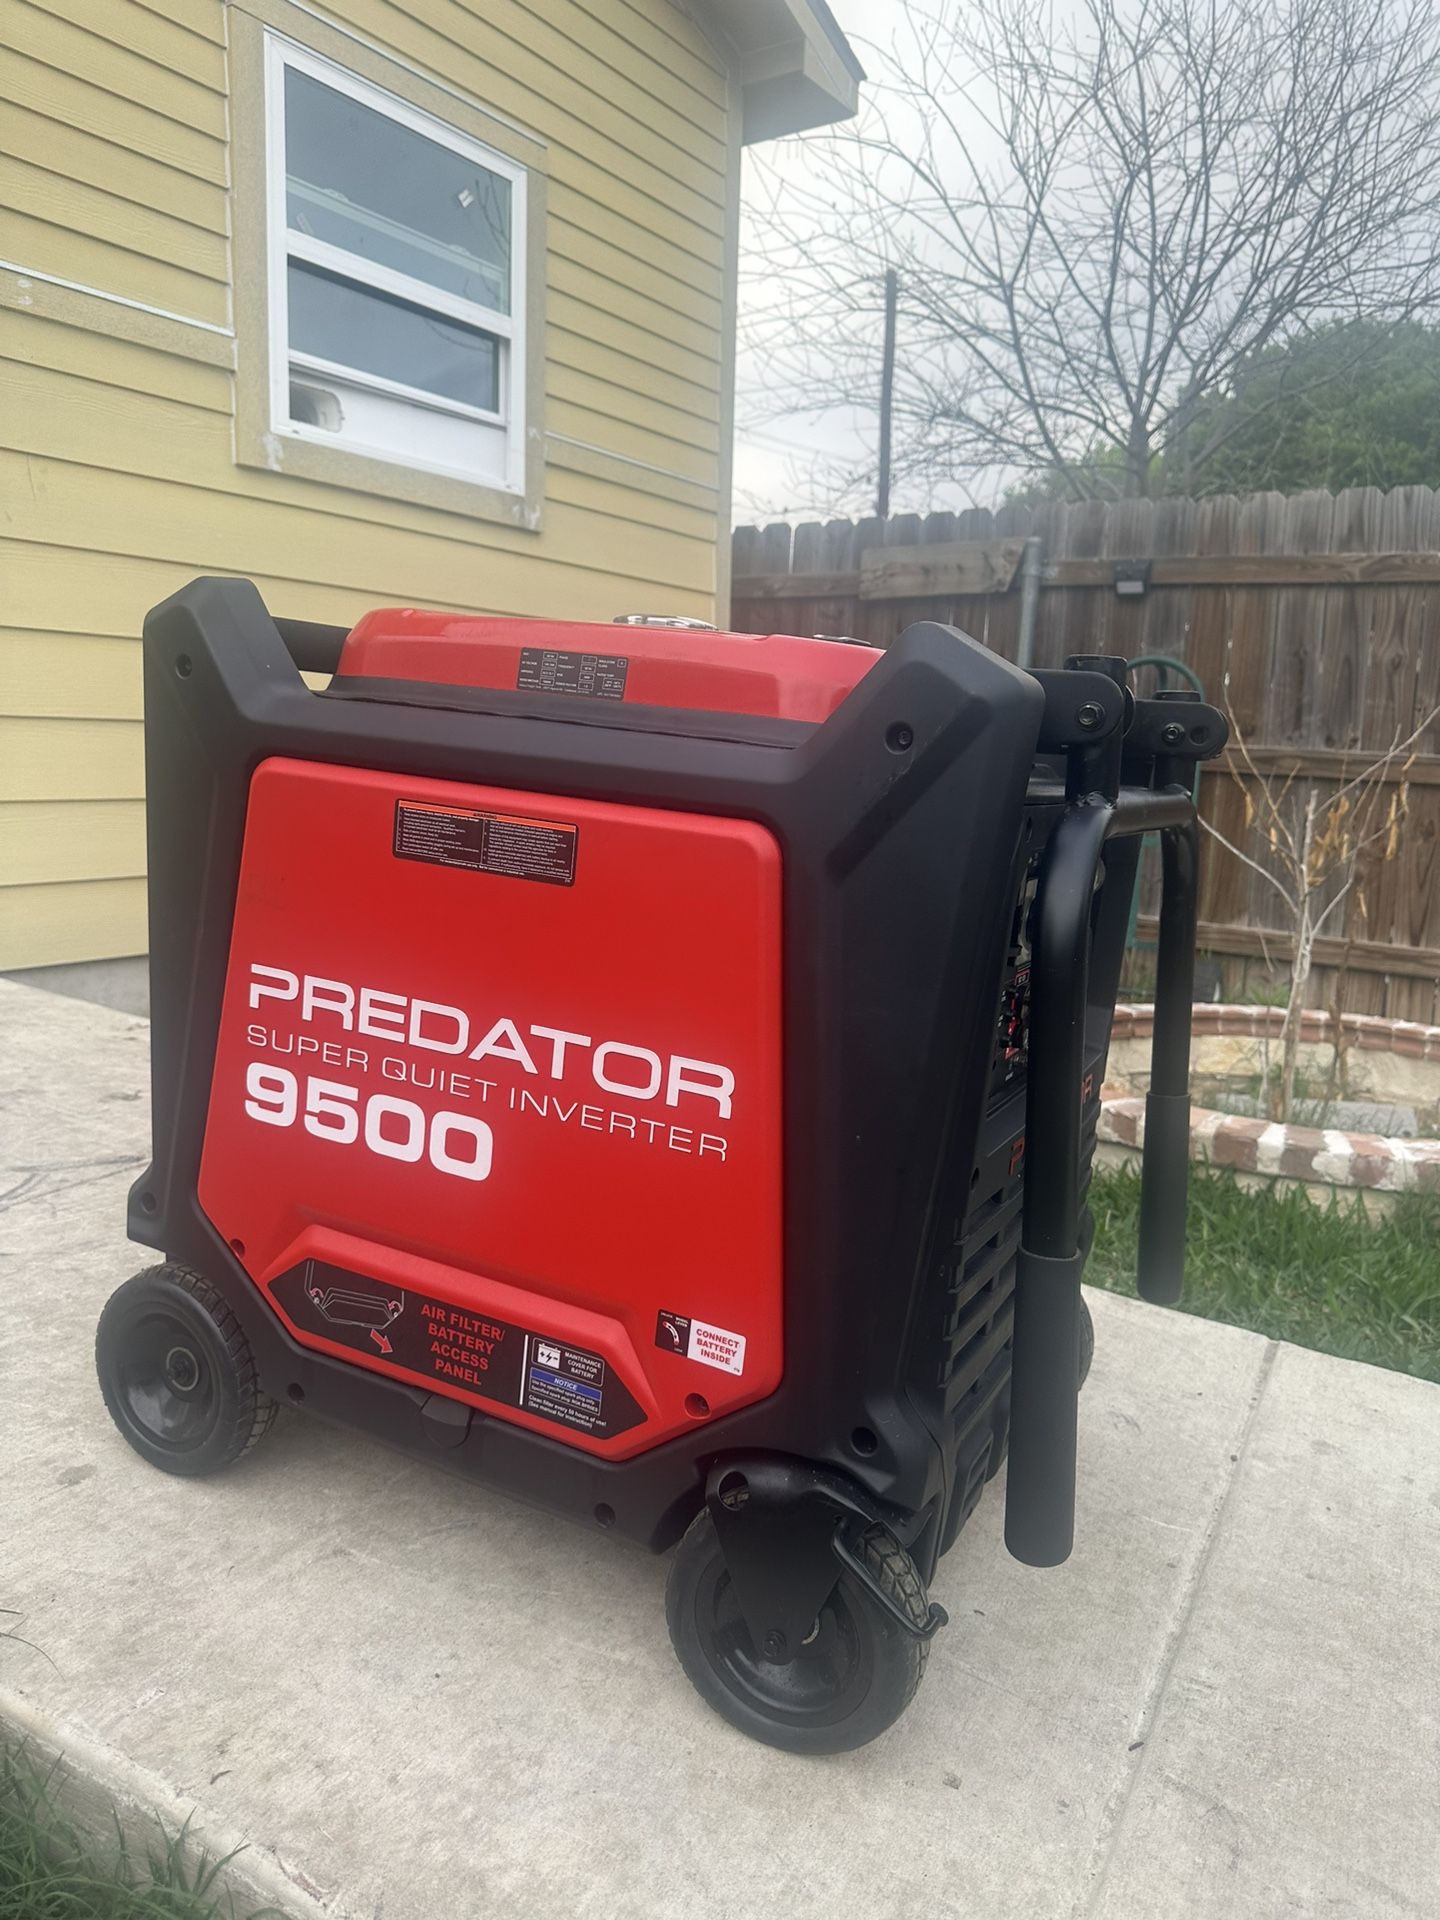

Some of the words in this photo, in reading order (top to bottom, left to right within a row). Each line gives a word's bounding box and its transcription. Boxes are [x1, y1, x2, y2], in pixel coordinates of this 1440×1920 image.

[249, 963, 736, 1119] PREDATOR
[247, 1024, 369, 1072] SUPER
[382, 1057, 498, 1102] QUIET
[509, 1087, 728, 1161] INVERTER
[244, 1061, 494, 1181] 9500
[421, 1304, 446, 1322] AIR
[450, 1313, 506, 1341] FILTER/
[428, 1323, 495, 1354] BATTERY
[696, 1328, 740, 1349] CONNECT
[696, 1338, 737, 1357] BATTERY
[431, 1341, 489, 1370] ACCESS
[564, 1351, 601, 1369] MAINTENANCE
[567, 1359, 586, 1370] COVER
[586, 1365, 598, 1374] FOR
[700, 1348, 731, 1366] INSIDE
[435, 1358, 482, 1385] PANEL
[553, 1378, 578, 1391] NOTICE
[570, 1367, 595, 1379] BATTERY
[528, 1394, 543, 1404] Clean
[543, 1398, 554, 1408] filter
[554, 1403, 567, 1414] every
[575, 1410, 589, 1420] hours
